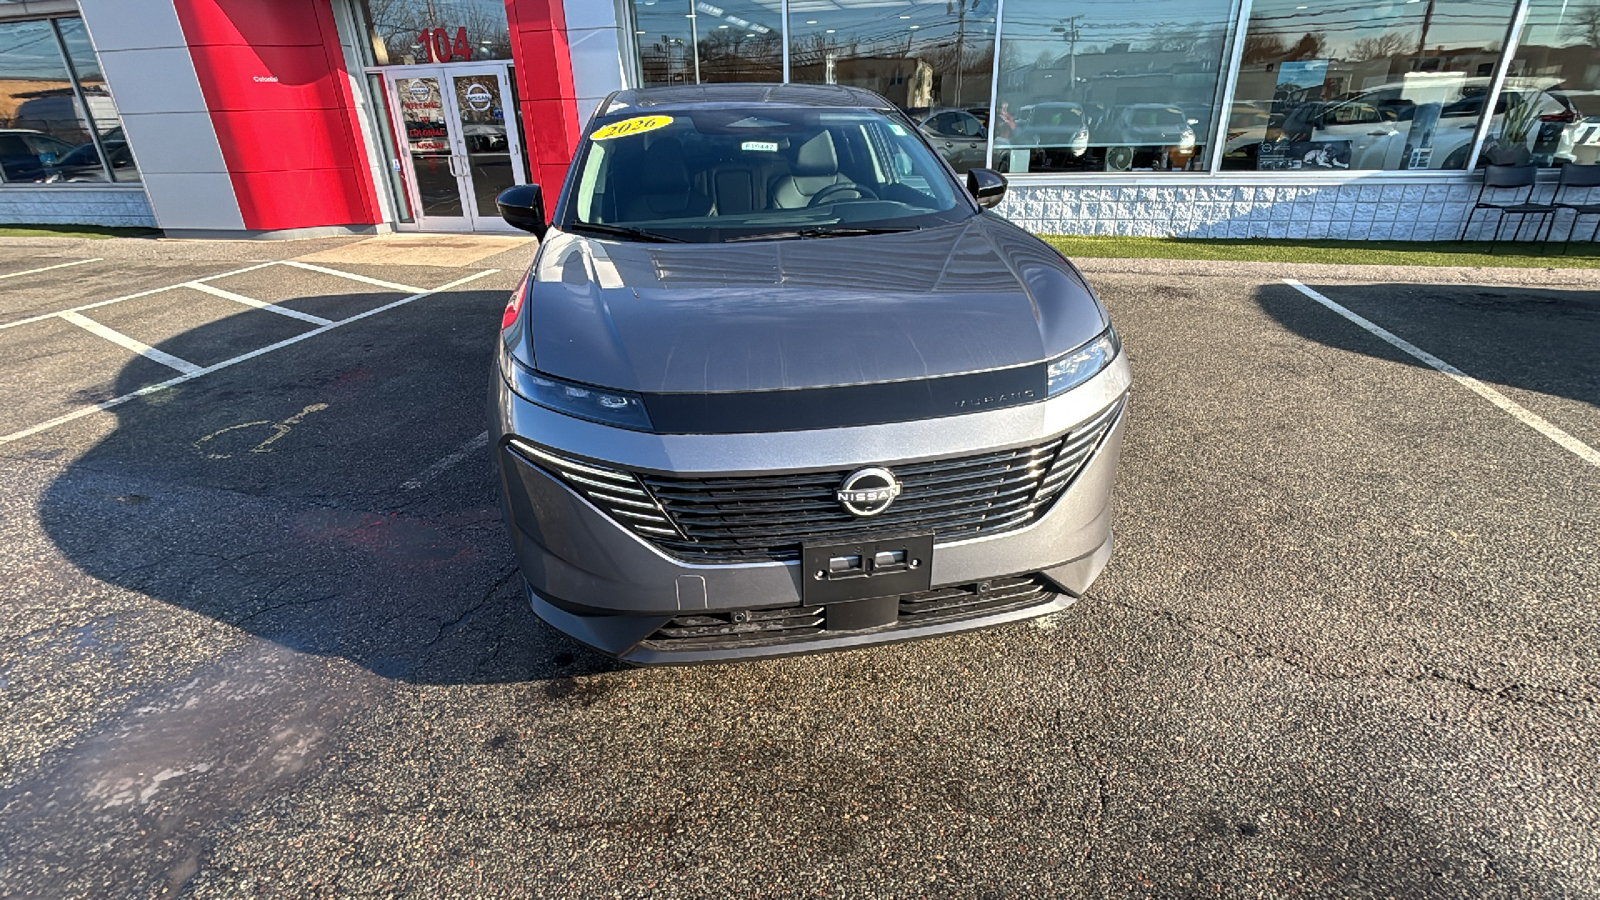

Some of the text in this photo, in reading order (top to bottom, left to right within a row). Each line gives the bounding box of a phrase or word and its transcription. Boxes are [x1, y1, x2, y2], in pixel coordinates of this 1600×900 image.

[418, 26, 472, 63] 104
[409, 129, 445, 137] COLONIAL
[603, 118, 656, 138] 2026
[837, 485, 900, 501] NISSAN
